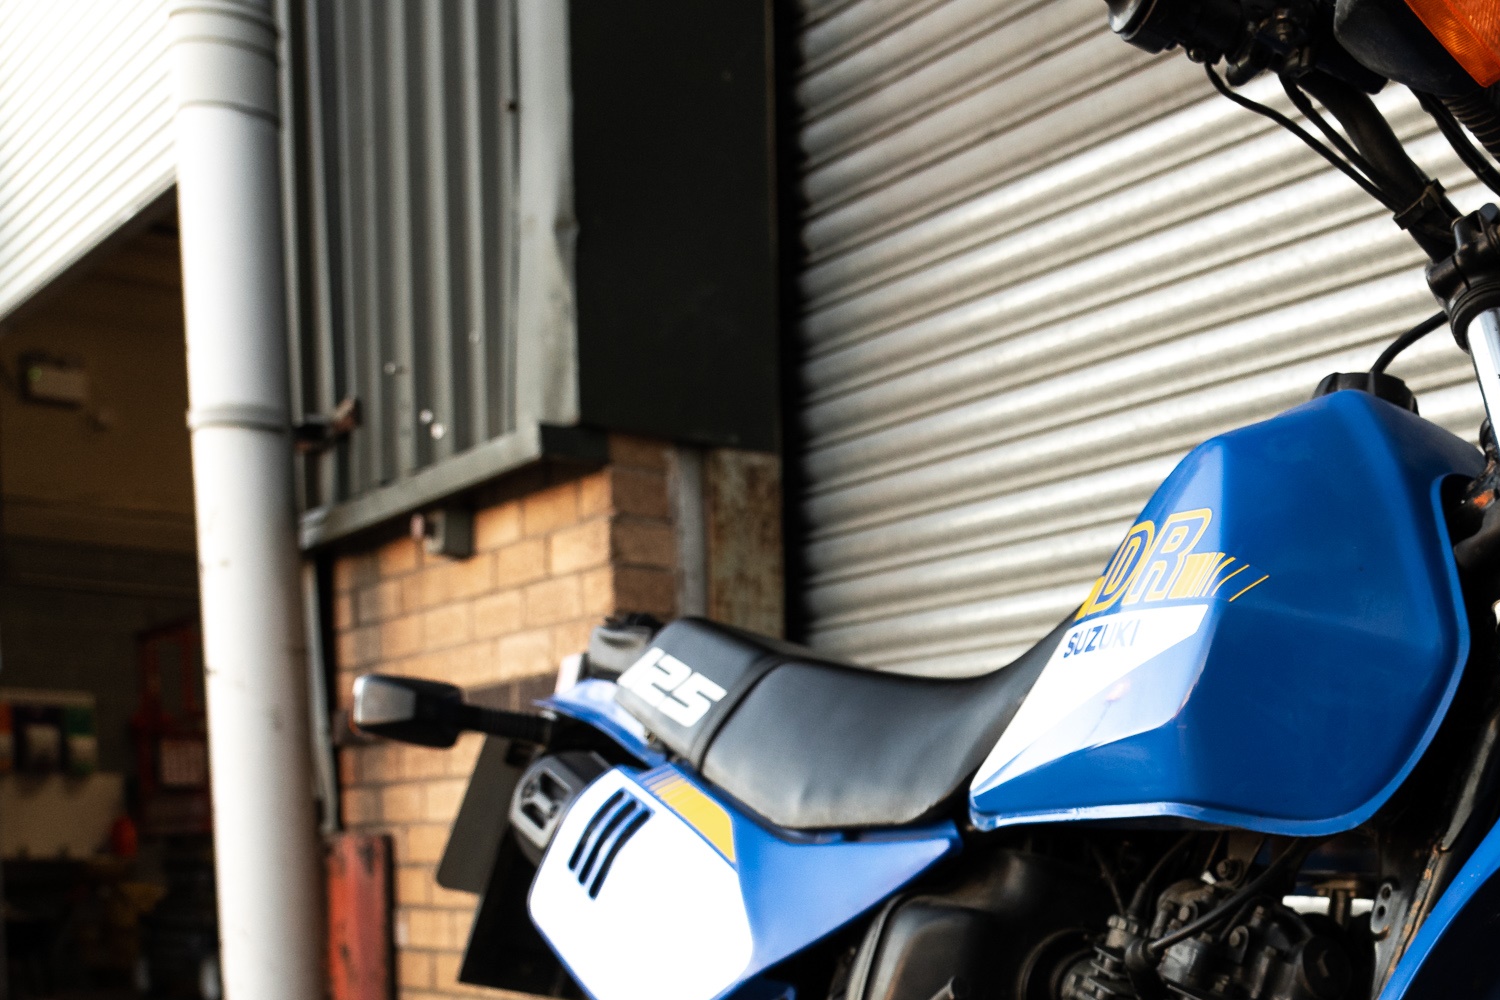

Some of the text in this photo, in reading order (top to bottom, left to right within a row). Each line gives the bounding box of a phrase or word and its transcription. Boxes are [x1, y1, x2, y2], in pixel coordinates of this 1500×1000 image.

[1085, 508, 1213, 616] DR
[1063, 620, 1141, 658] SUZUKI
[616, 646, 728, 728] 125
